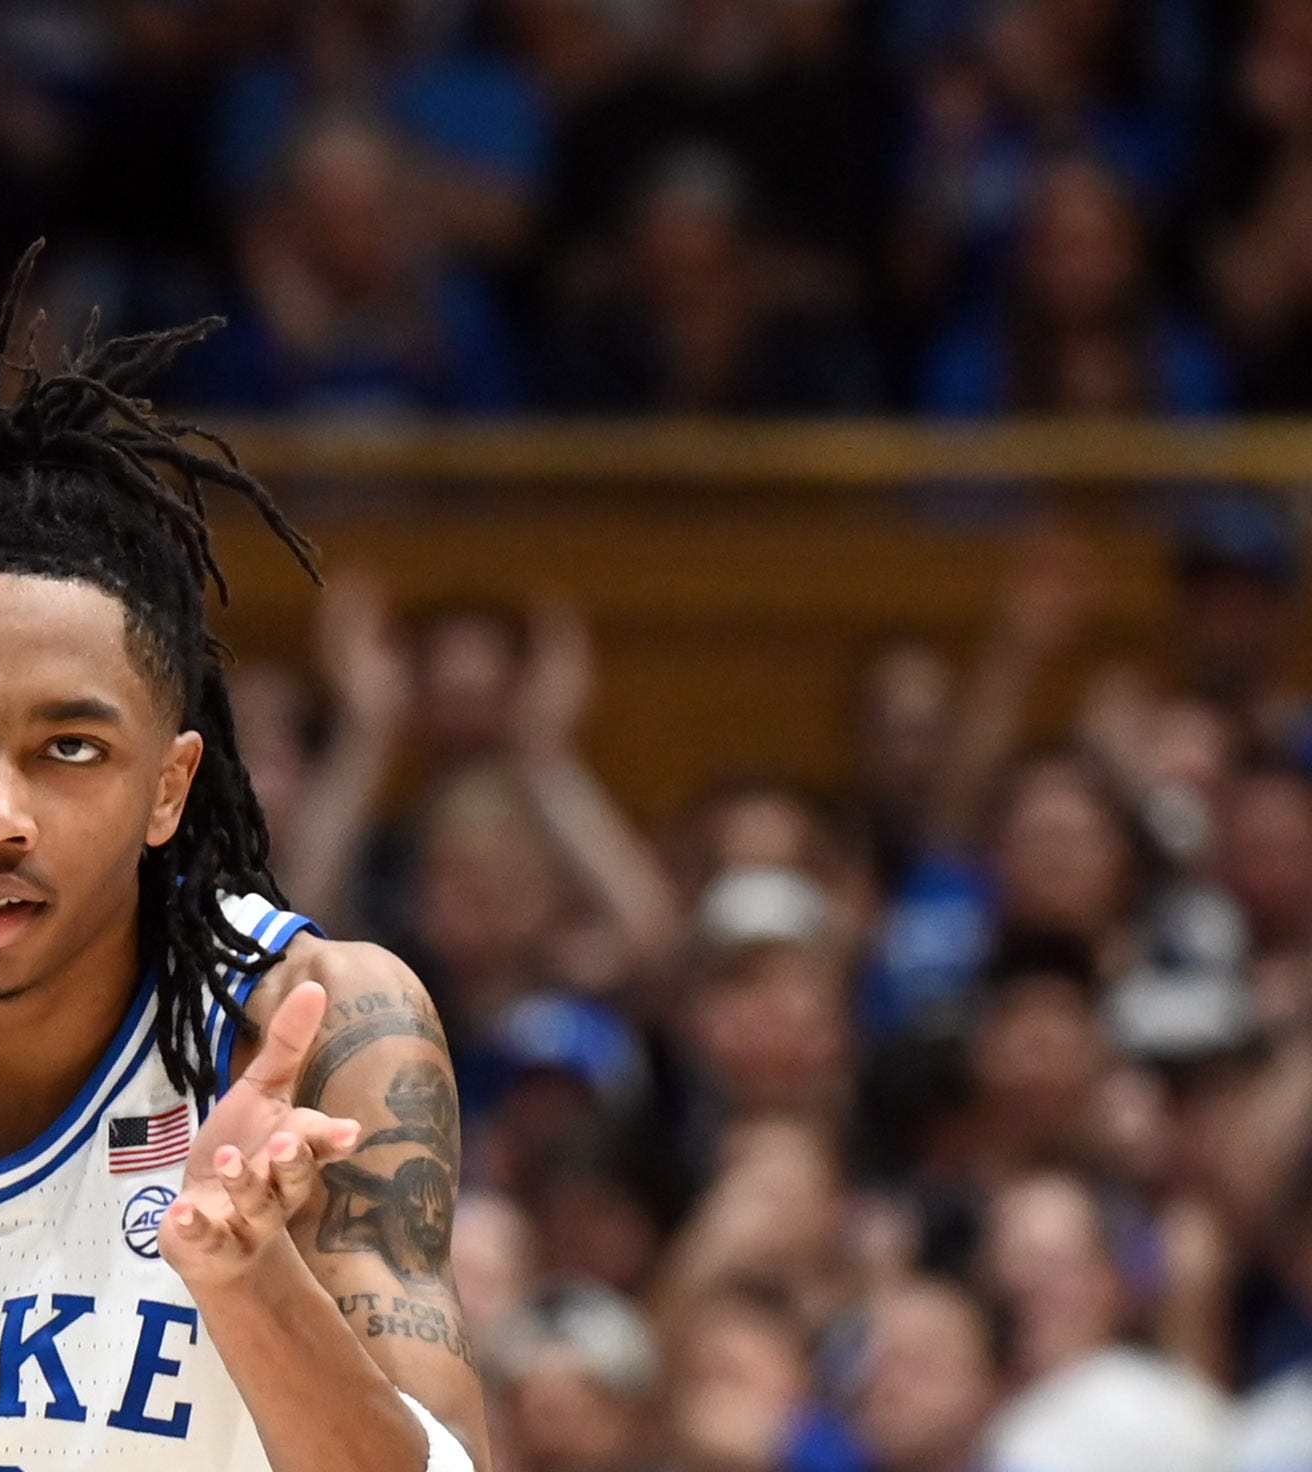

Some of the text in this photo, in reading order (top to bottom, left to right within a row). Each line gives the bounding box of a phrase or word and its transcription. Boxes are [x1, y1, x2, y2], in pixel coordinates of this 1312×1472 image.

[131, 1208, 167, 1228] AC
[336, 1292, 451, 1331] UT FOR
